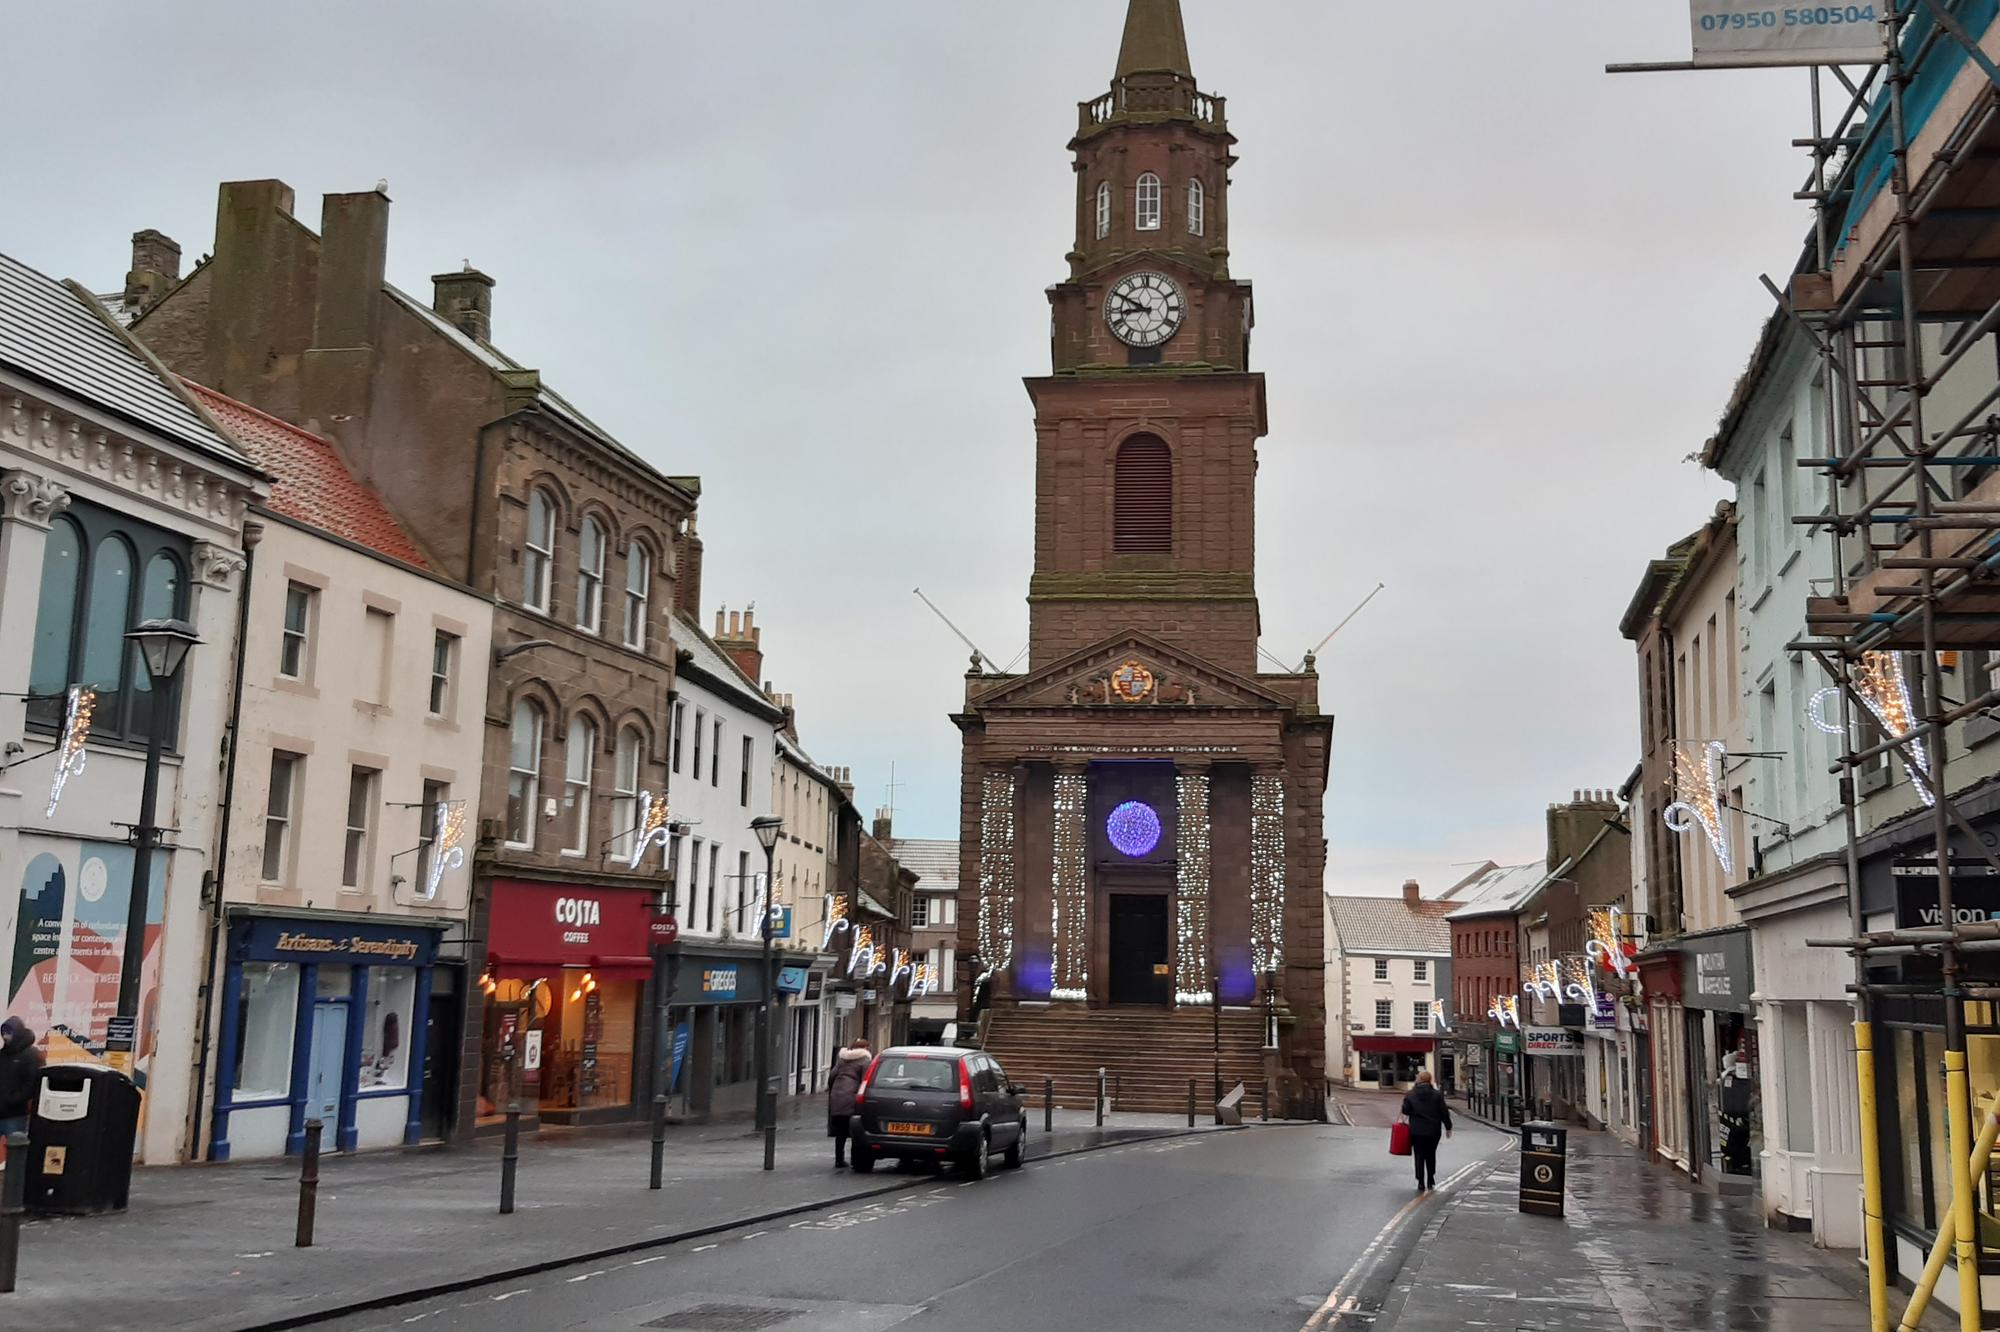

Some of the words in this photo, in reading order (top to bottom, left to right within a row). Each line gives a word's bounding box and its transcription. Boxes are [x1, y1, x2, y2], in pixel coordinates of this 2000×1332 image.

[1700, 11, 1776, 31] 07950
[1783, 5, 1876, 26] 580504
[555, 897, 600, 927] COSTA
[651, 923, 676, 931] COSTA
[564, 932, 590, 943] COFFEE
[350, 936, 419, 960] Serendipity
[1528, 1032, 1574, 1042] SPORTS
